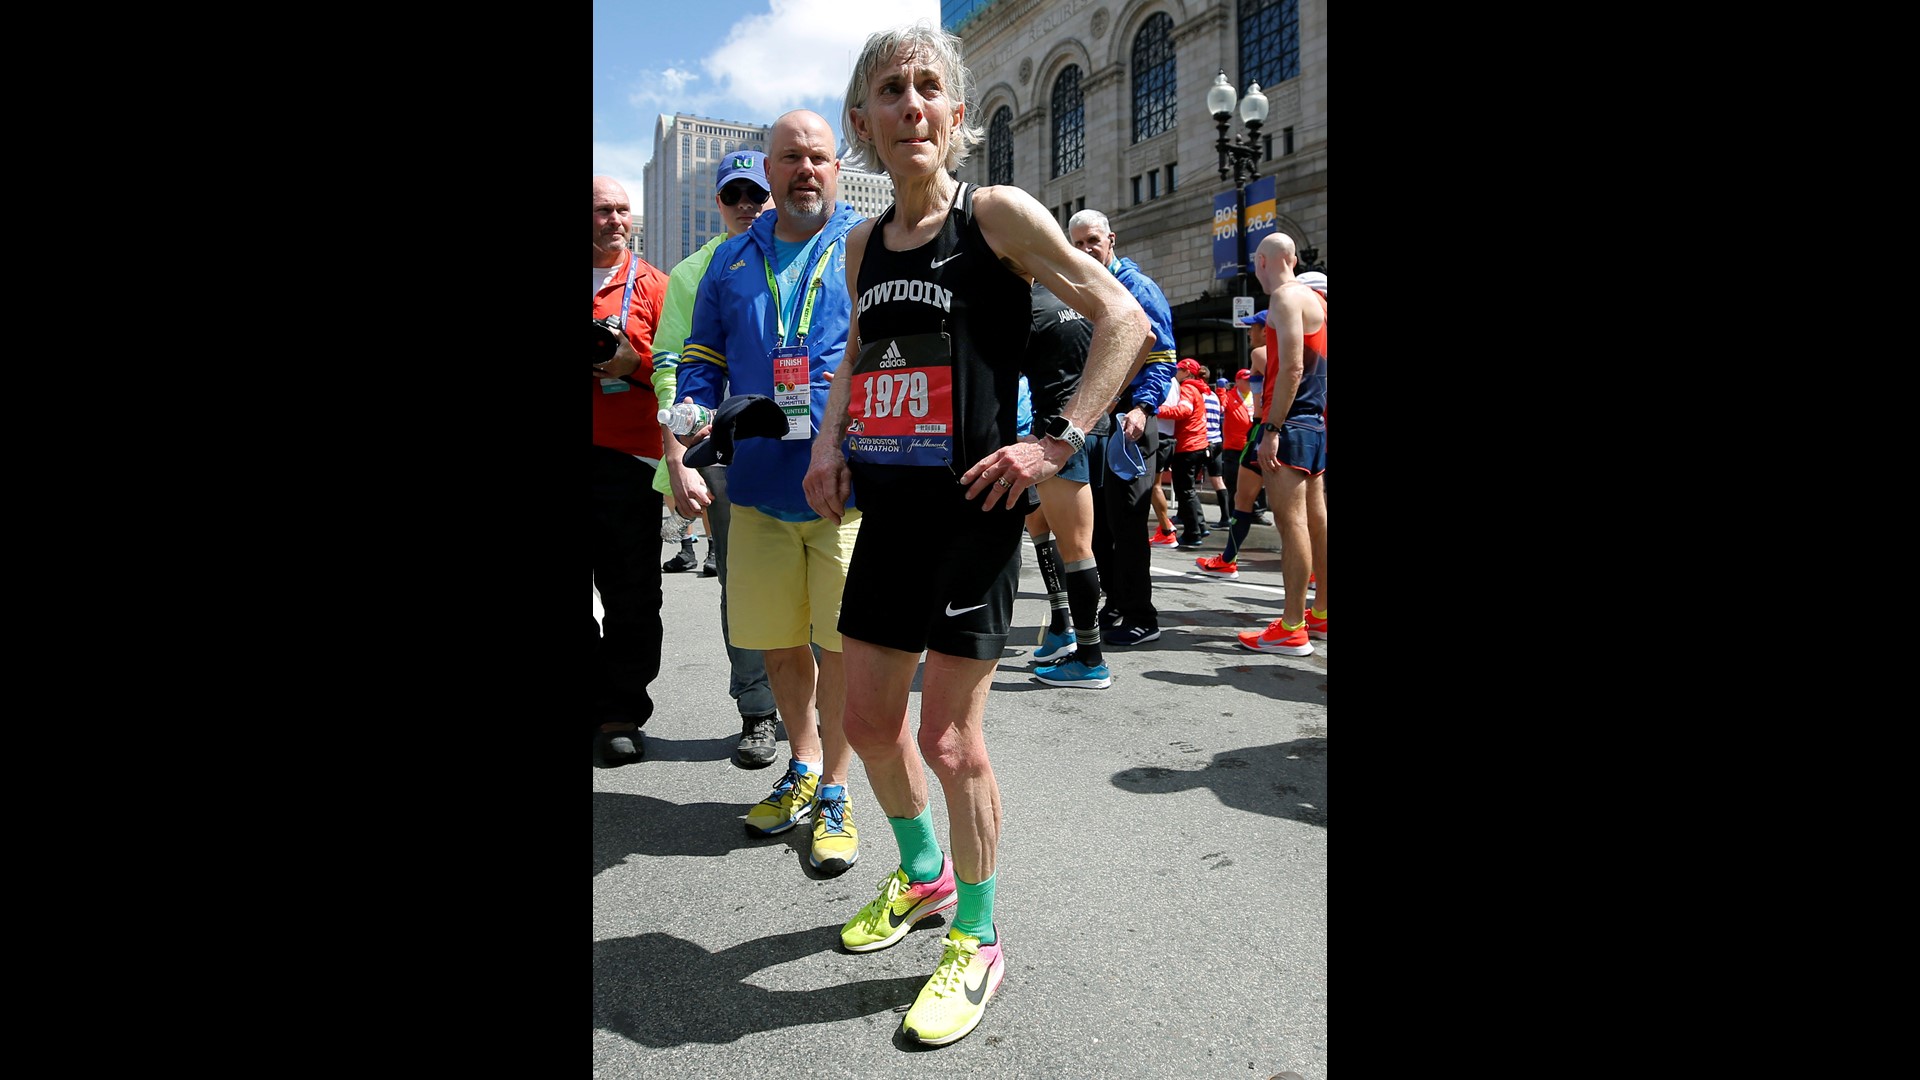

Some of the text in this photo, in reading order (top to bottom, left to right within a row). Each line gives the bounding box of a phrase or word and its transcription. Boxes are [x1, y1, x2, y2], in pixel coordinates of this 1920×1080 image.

[1247, 211, 1274, 233] 26.2
[779, 358, 802, 367] FINISH
[879, 356, 907, 369] adidas
[863, 371, 929, 418] 1979
[872, 438, 898, 446] BOSTON
